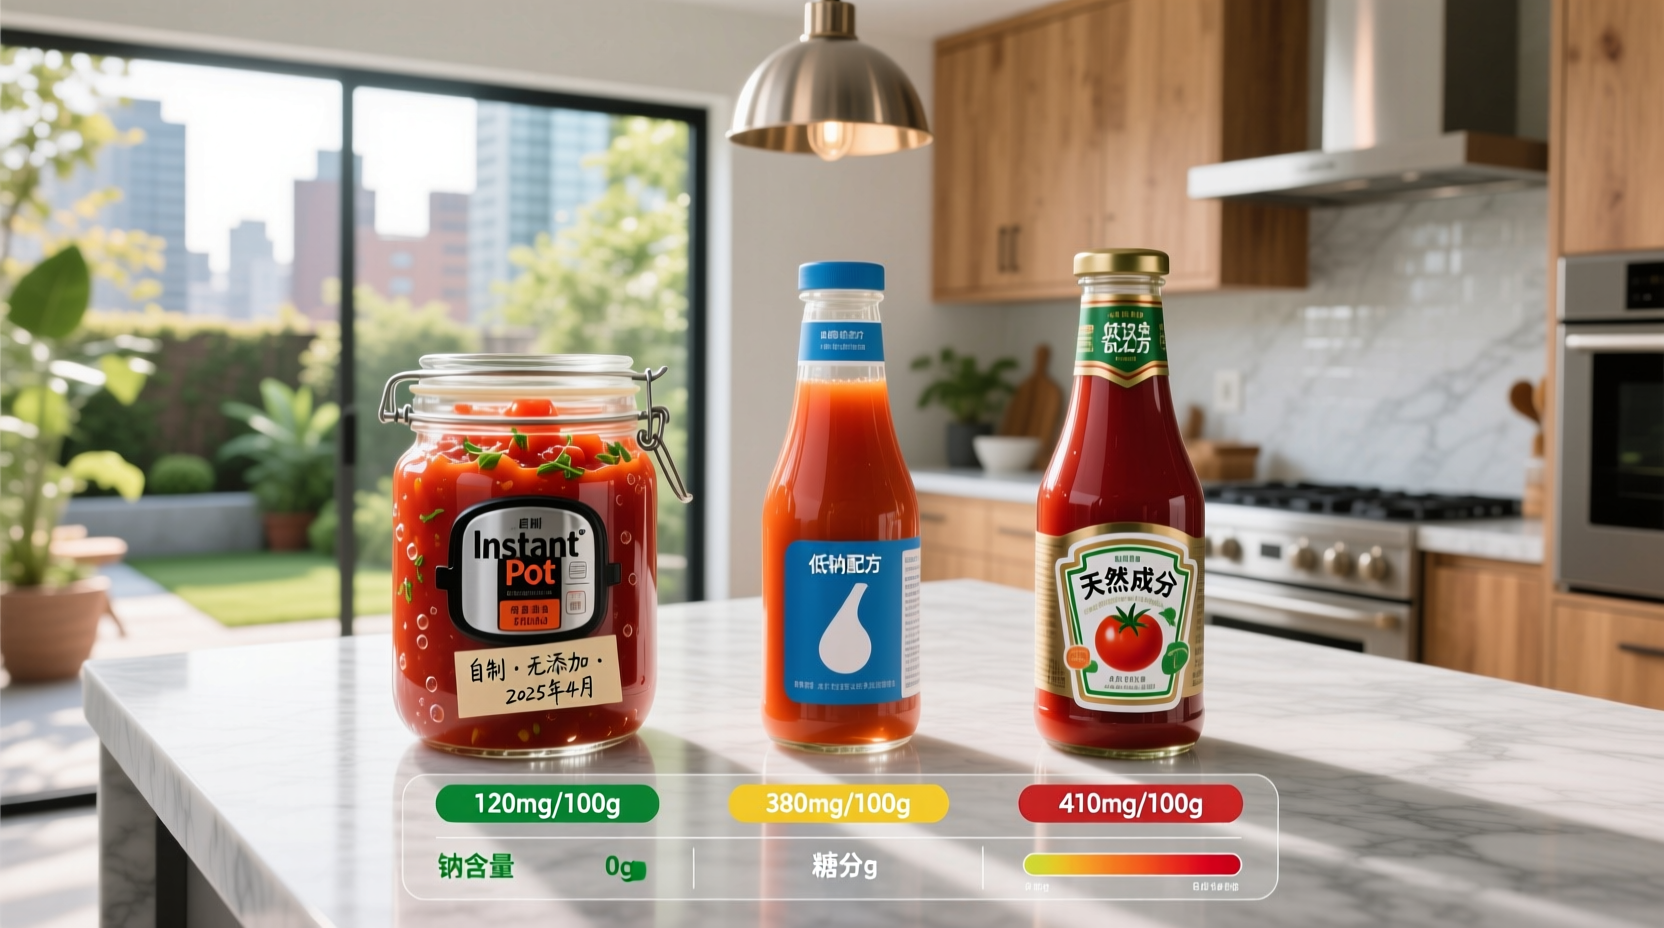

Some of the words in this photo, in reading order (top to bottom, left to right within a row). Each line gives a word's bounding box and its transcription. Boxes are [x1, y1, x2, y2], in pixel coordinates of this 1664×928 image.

[474, 530, 579, 559] Instant
[506, 559, 556, 586] Pot
[1079, 566, 1178, 601] 天然成分
[506, 675, 593, 705] 2025年4月
